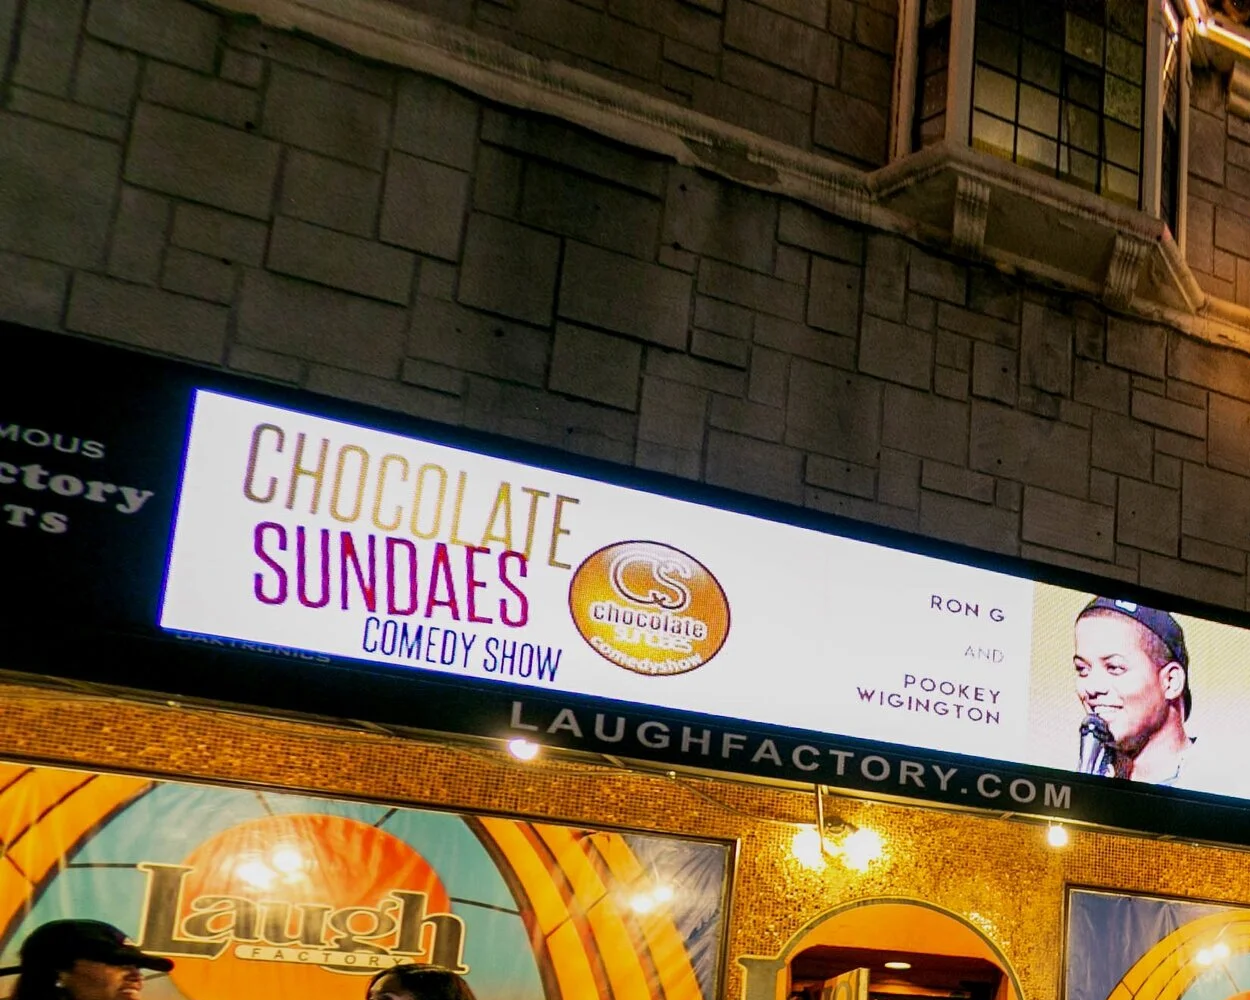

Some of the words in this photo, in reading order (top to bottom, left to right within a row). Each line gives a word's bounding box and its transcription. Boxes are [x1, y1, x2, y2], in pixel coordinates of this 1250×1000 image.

[0, 423, 106, 459] MOUS
[0, 460, 155, 514] ctory
[243, 422, 580, 570] CHOCOLATE
[3, 503, 69, 534] TS
[253, 520, 529, 629] SUNDAES
[588, 600, 709, 641] chocolate
[930, 594, 980, 618] RON
[989, 607, 1006, 623] G
[362, 616, 476, 669] COMEDY
[483, 636, 563, 683] SHOW
[964, 645, 1005, 664] AND
[856, 686, 1001, 725] WIGINGTON
[904, 673, 1001, 705] POOKEY
[509, 700, 1073, 810] LAUGHFACTORY.COM
[137, 862, 470, 974] Laugh
[251, 947, 403, 966] FACTORY
